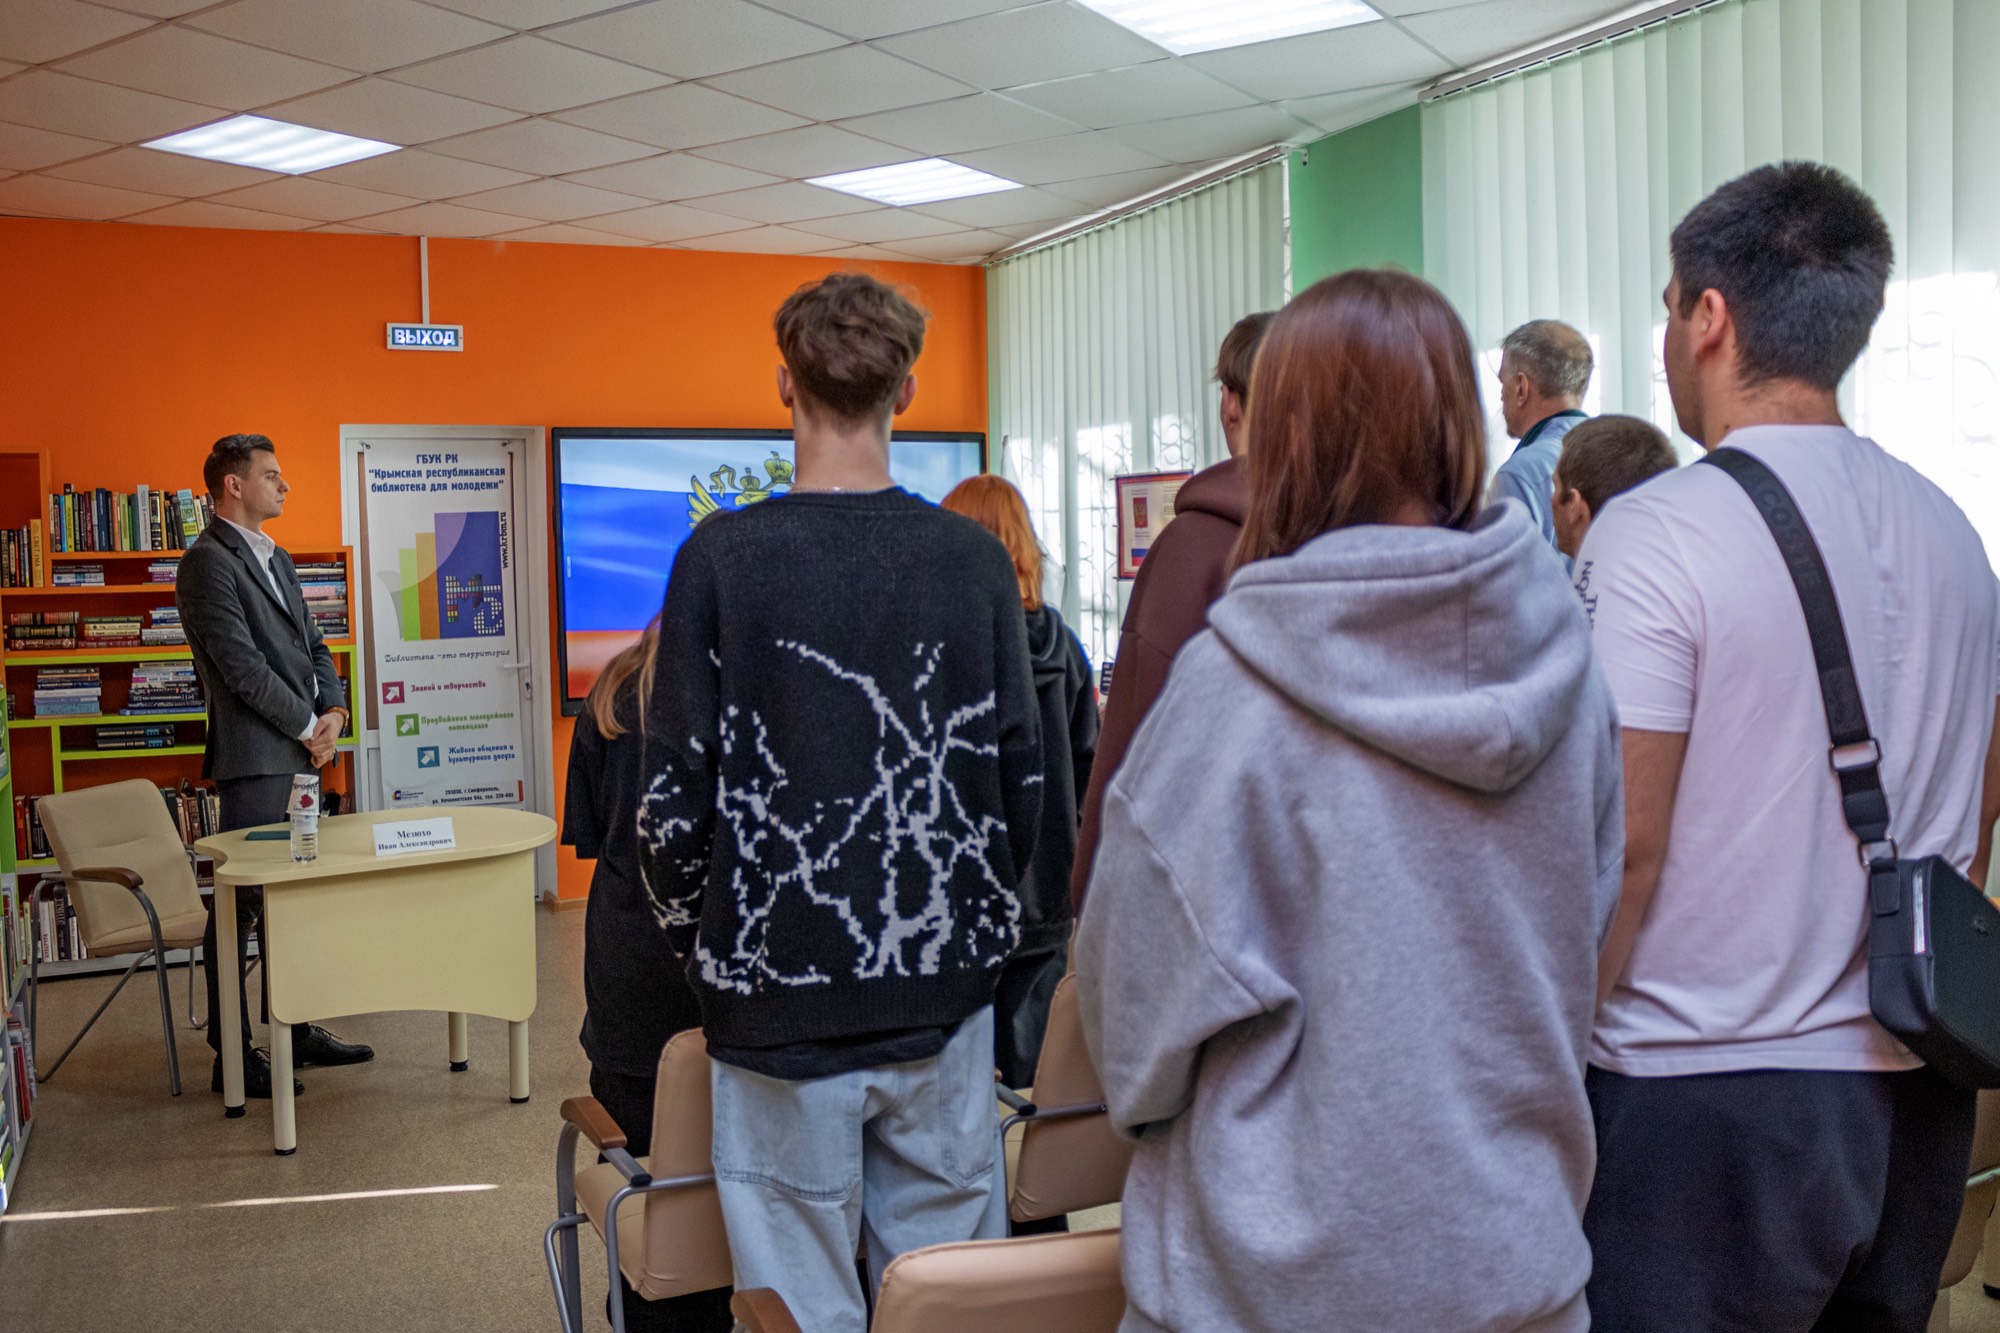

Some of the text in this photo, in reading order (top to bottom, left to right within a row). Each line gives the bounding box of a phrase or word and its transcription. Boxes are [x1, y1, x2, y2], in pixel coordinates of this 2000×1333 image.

[394, 329, 455, 346] ВЫХОД
[416, 454, 458, 464] ГБУК РК
[426, 467, 506, 479] республиканская
[371, 482, 426, 492] библиотека
[430, 483, 448, 492] для
[500, 512, 508, 569] www.krbm.ru
[459, 650, 510, 660] территория
[411, 682, 436, 692] Знаний
[444, 680, 486, 692] творчества
[448, 746, 476, 755] Живого
[478, 744, 508, 753] общения
[448, 752, 515, 764] культурного досуга
[397, 830, 432, 839] Мезюхо
[399, 838, 452, 849] Александрович
